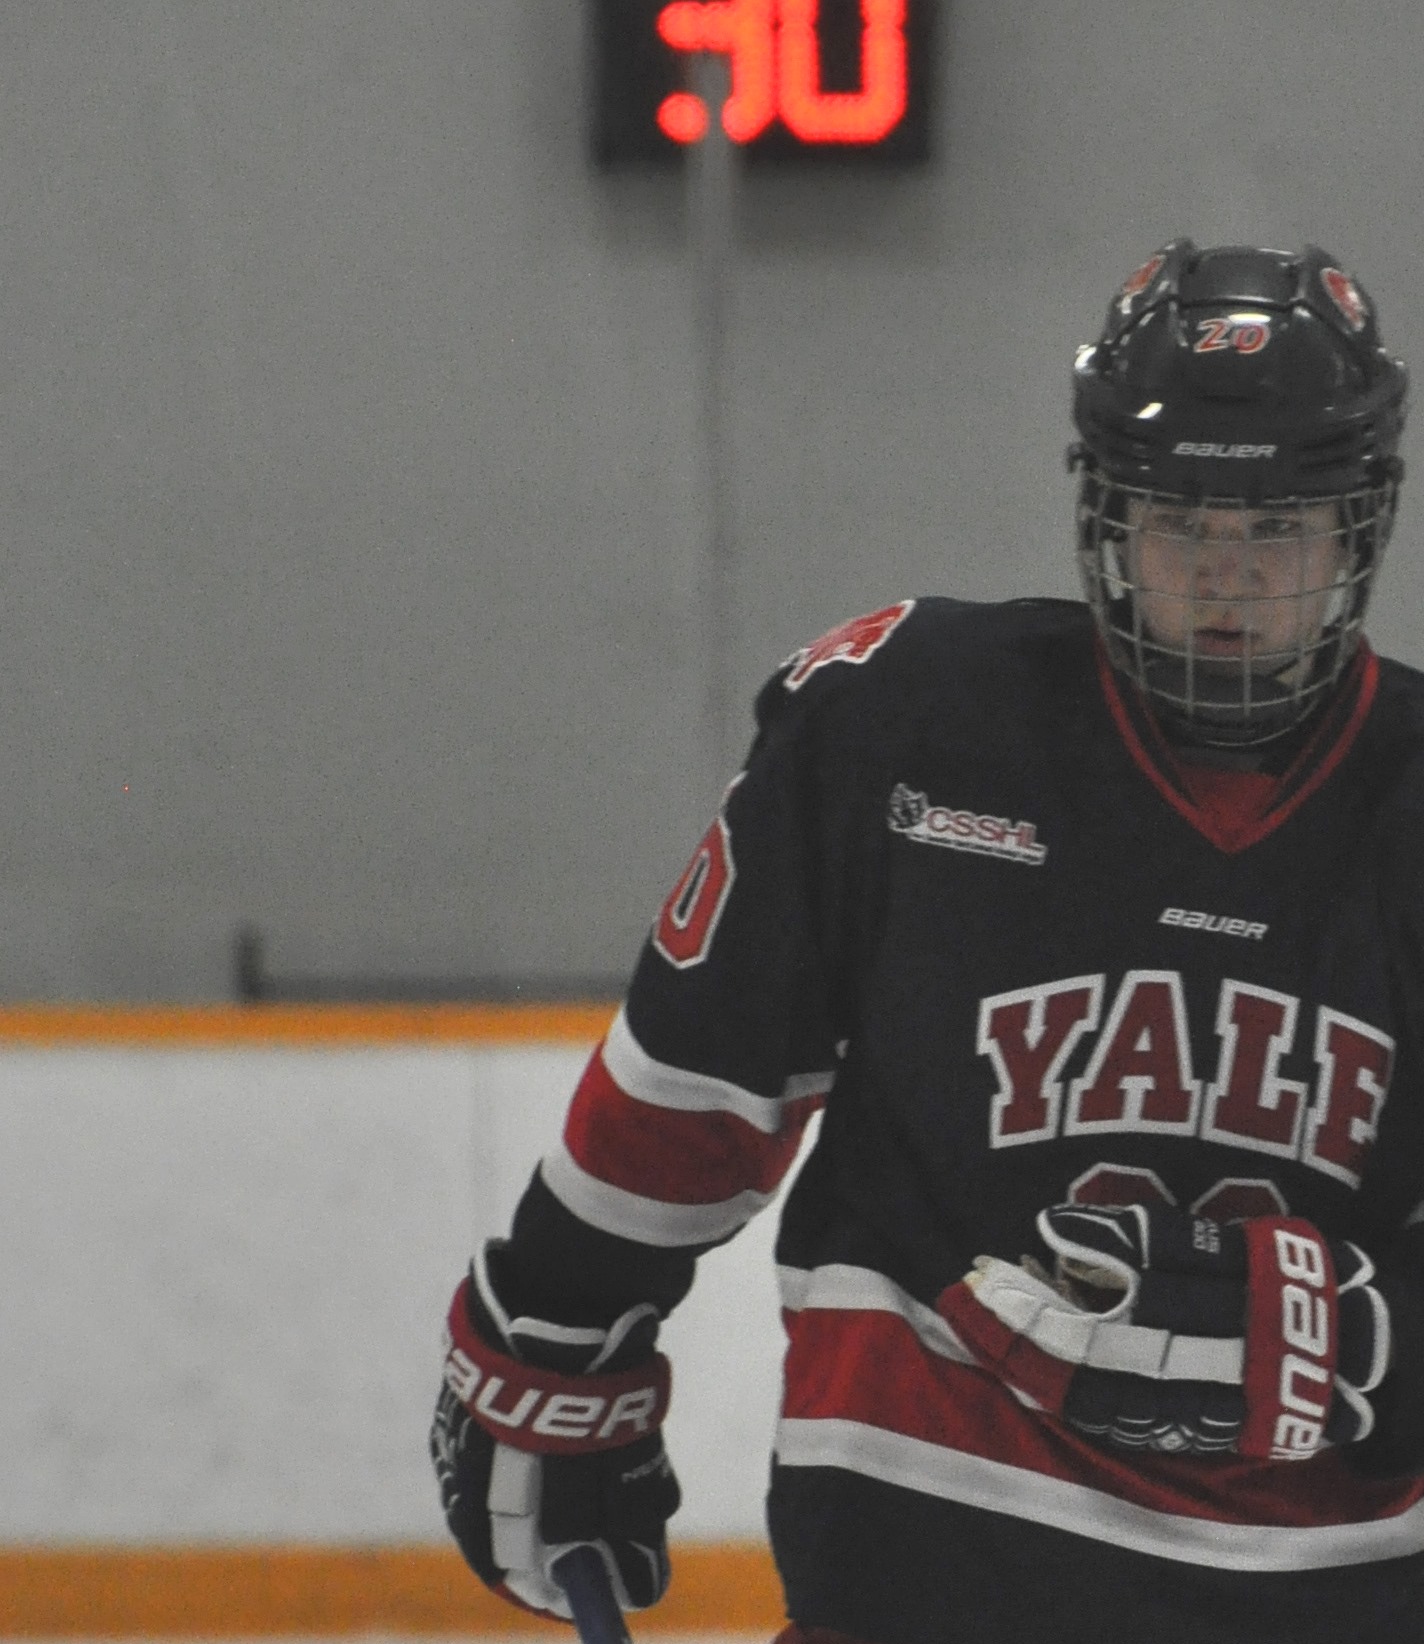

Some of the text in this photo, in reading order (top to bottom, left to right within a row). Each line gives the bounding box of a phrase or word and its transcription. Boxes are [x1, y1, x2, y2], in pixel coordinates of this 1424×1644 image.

[1193, 317, 1271, 353] 20
[1172, 441, 1278, 458] BAUER
[925, 806, 1042, 849] CSSHL
[653, 770, 748, 970] 0
[1158, 907, 1269, 941] BAUER
[976, 970, 1397, 1190] YALE
[1269, 1228, 1329, 1462] BAUE
[446, 1348, 658, 1439] AUER
